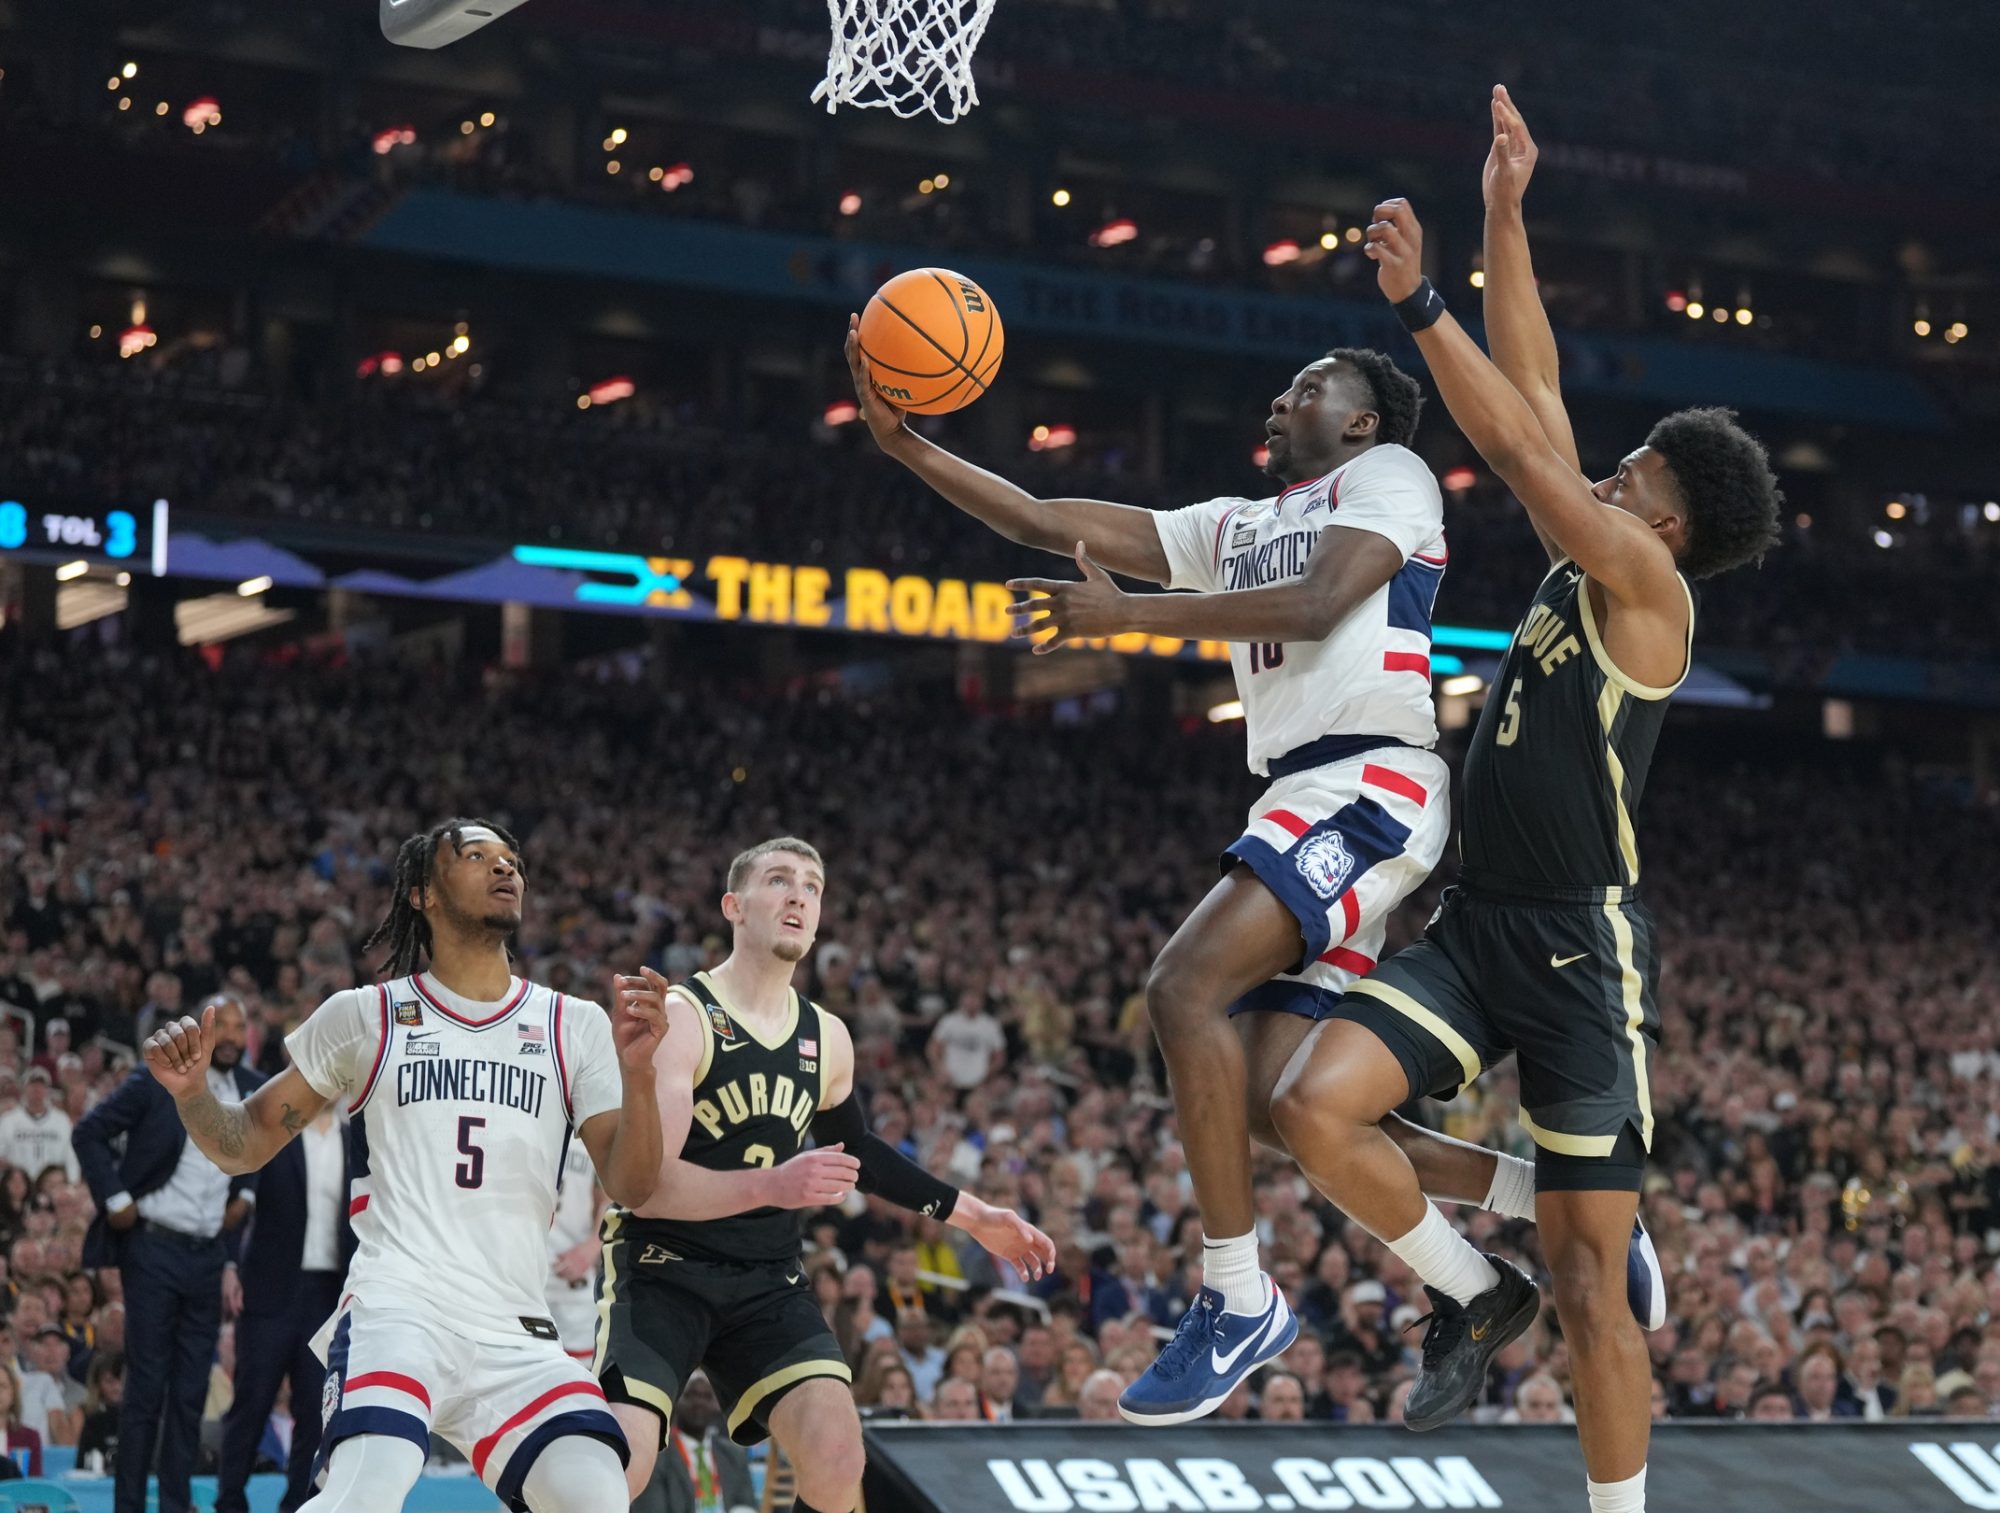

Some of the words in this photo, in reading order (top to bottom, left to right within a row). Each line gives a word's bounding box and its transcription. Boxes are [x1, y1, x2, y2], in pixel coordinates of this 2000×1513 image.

[42, 513, 101, 547] TOL
[105, 510, 136, 558] 3
[705, 554, 831, 627] THE
[845, 567, 1014, 643] ROAD
[1496, 677, 1524, 746] 5
[397, 1058, 547, 1118] CONNECTICUT
[693, 1072, 814, 1141] PURDU
[455, 1115, 486, 1189] 5
[986, 1456, 1503, 1512] USAB.COM
